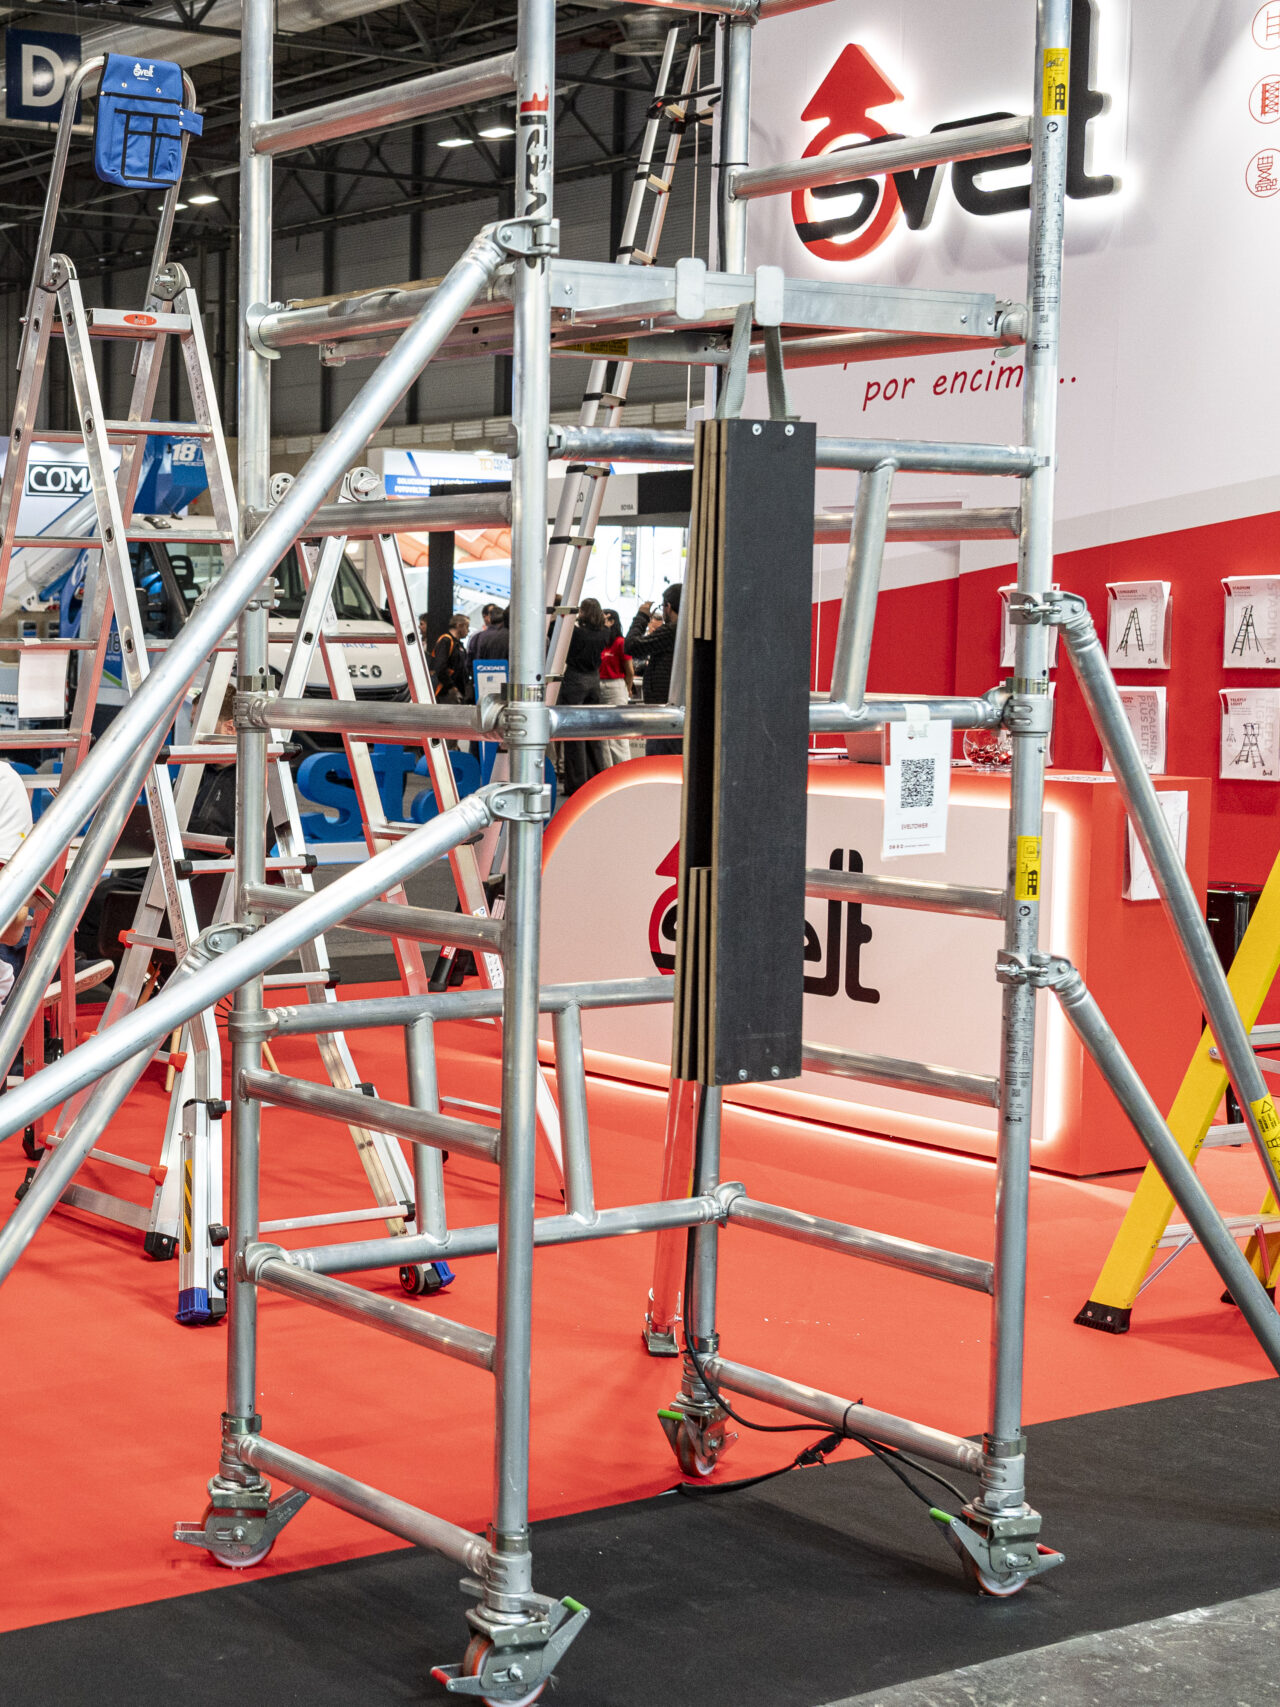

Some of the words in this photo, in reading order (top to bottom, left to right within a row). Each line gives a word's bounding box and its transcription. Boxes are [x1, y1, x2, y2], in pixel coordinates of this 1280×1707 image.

[22, 44, 67, 107] D
[863, 377, 915, 411] por
[348, 664, 382, 678] ECO
[1137, 694, 1149, 722] PLUS
[1140, 724, 1150, 756] ELITE
[1146, 694, 1159, 763] ESCALISIMA
